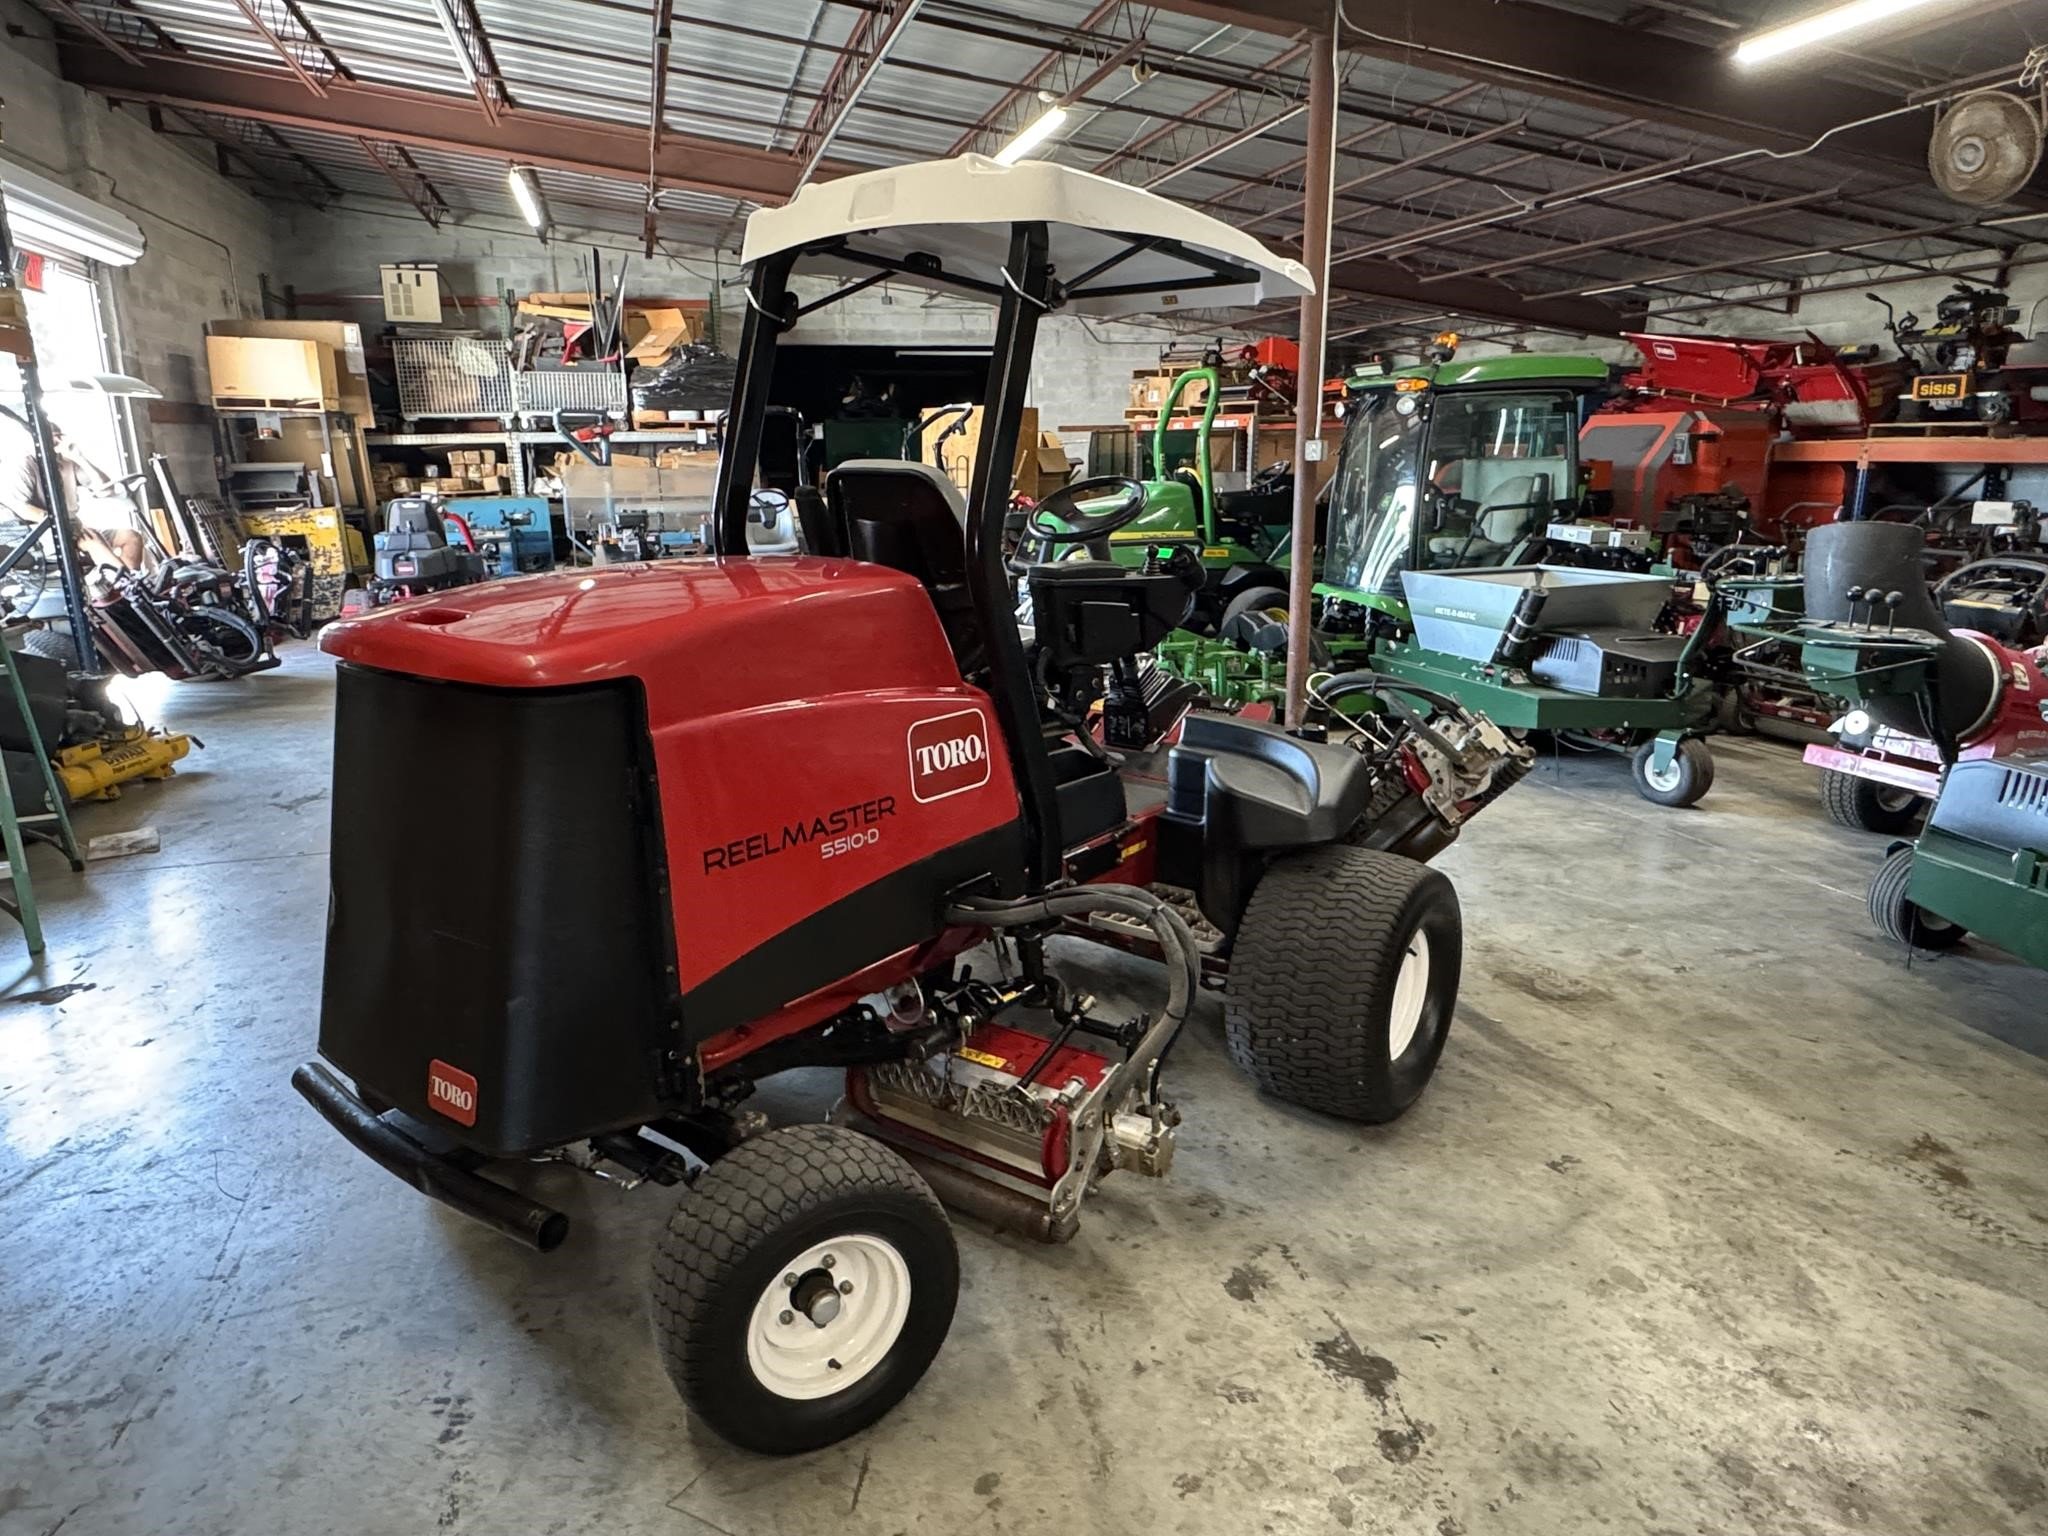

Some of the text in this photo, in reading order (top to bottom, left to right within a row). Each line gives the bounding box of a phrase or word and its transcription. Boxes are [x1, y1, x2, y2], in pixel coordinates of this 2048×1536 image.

[916, 734, 982, 775] TORO
[703, 796, 896, 874] REELMASTER
[431, 1076, 472, 1110] TORO
